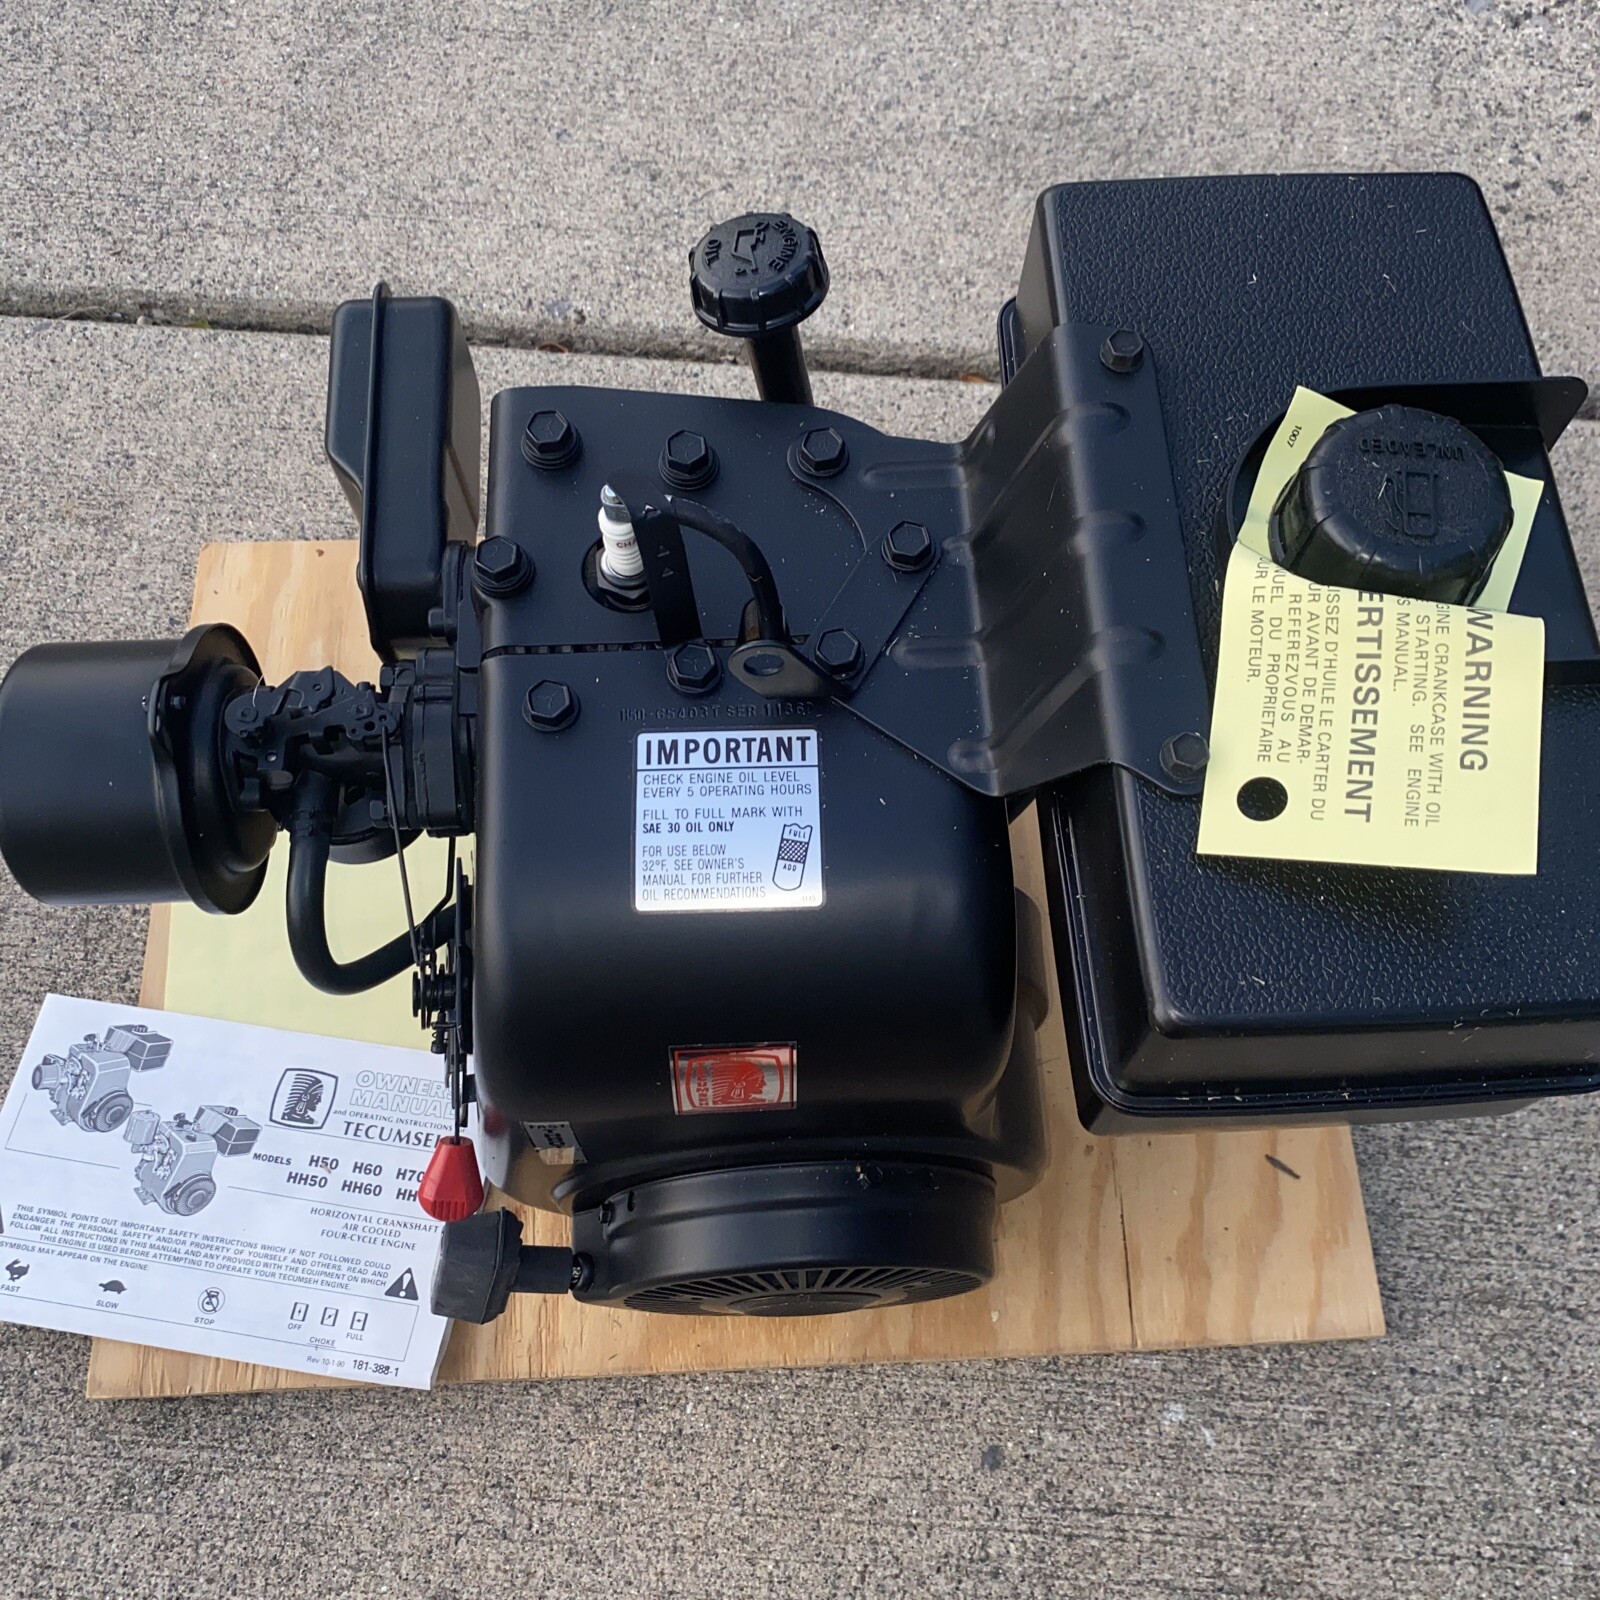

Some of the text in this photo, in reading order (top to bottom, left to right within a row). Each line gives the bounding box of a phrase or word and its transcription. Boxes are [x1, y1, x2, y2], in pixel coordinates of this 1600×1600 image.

[1287, 426, 1302, 448] 1007
[1359, 439, 1465, 461] UNLEADED
[1252, 586, 1267, 603] LE
[1269, 617, 1283, 640] DU
[1246, 610, 1263, 684] MOTEUR.
[1303, 611, 1318, 670] AVANT
[1393, 612, 1409, 692] MANUAL.
[1411, 615, 1430, 707] STARTING.
[1277, 594, 1302, 763] REFEREZVOUS AU
[1302, 676, 1316, 698] DE
[1459, 607, 1494, 772] WARNING
[1257, 653, 1280, 763] PROPRIETAIRE
[1310, 588, 1340, 821] ISSEZ D'HUILE LE CARTER DU
[1344, 590, 1384, 823] ERTISSEMENT
[1425, 604, 1450, 828] GINE CRANKCASE WITH OIL
[1297, 704, 1314, 765] DEMAR-
[1409, 724, 1424, 753] SEE
[645, 736, 811, 766] IMPORTANT
[644, 771, 800, 786] CHECK ENGINE OIL LEVEL
[643, 783, 812, 798] EVERY 5 OPERATING HOURS
[1404, 769, 1422, 827] ENGINE
[643, 806, 803, 820] FILL TO FULL MARK WITH
[643, 821, 735, 834] SAE 30 OIL ONLY
[788, 828, 806, 839] FULL
[642, 844, 726, 857] FOR USE BELOW
[673, 859, 693, 871] SEE
[698, 858, 745, 870] OWNER'S
[783, 863, 797, 872] ADD
[642, 872, 762, 886] MANUAL FOR FURTHER
[642, 886, 766, 901] OIL RECOMMENDATIONS
[350, 1089, 456, 1120] MANUAL
[334, 1108, 452, 1132] and OPERATING INSTRUCTIONS
[253, 1152, 424, 1182] MODELS H50 H60 H70
[286, 1171, 417, 1202] HH50 HH60 HH
[310, 1207, 439, 1233] HORIZONTAL CRANKSHAFT
[341, 1223, 402, 1238] AIR COOLED
[12, 1213, 56, 1225] ENDANGER
[59, 1219, 74, 1228] THE
[77, 1222, 118, 1235] PERSONAL
[122, 1230, 153, 1240] SAFETY
[156, 1235, 187, 1246] AND/OR
[190, 1241, 231, 1255] PROPERTY
[248, 1250, 288, 1263] YOURSELF
[291, 1257, 308, 1266] AND
[346, 1265, 368, 1275] READ
[371, 1269, 389, 1279] AND
[16, 1204, 35, 1212] THIS
[37, 1208, 68, 1218] SYMBOL
[71, 1213, 98, 1223] POINTS
[100, 1217, 118, 1227] OUT
[120, 1221, 166, 1234] IMPORTANT
[168, 1228, 200, 1239] SAFETY
[202, 1234, 258, 1250] INSTRUCTIONS
[260, 1243, 286, 1254] WHICH
[300, 1249, 316, 1259] NOT
[318, 1252, 362, 1266] FOLLOWED
[364, 1260, 391, 1270] COULD
[320, 1229, 417, 1251] FOUR-CYCLE ENGINE
[9, 1221, 387, 1287] FOLLOW ALL INSTRUCTIONS IN THIS MANUAL AND ANY PROVIDED WITH THE EQUIPMENT ON WHICH
[37, 1247, 56, 1255] MAY
[57, 1250, 88, 1262] APPEAR
[89, 1255, 100, 1263] ON
[104, 1258, 118, 1266] THE
[39, 1235, 56, 1244] THIS
[58, 1237, 88, 1248] ENGINE
[89, 1241, 96, 1249] IS
[98, 1243, 118, 1252] USED
[119, 1247, 150, 1258] BEFORE
[151, 1252, 203, 1267] ATTEMPTING
[204, 1261, 215, 1269] TO
[215, 1262, 252, 1274] OPERATE
[254, 1268, 276, 1278] YOUR
[278, 1272, 319, 1285] TECUMSEH
[0, 1284, 21, 1292] FAST
[96, 1300, 119, 1309] SLOW
[194, 1316, 215, 1325] STOP
[288, 1322, 302, 1331] OFF
[309, 1336, 336, 1346] CHOKE
[346, 1333, 363, 1341] FULL
[306, 1355, 319, 1364] Rev
